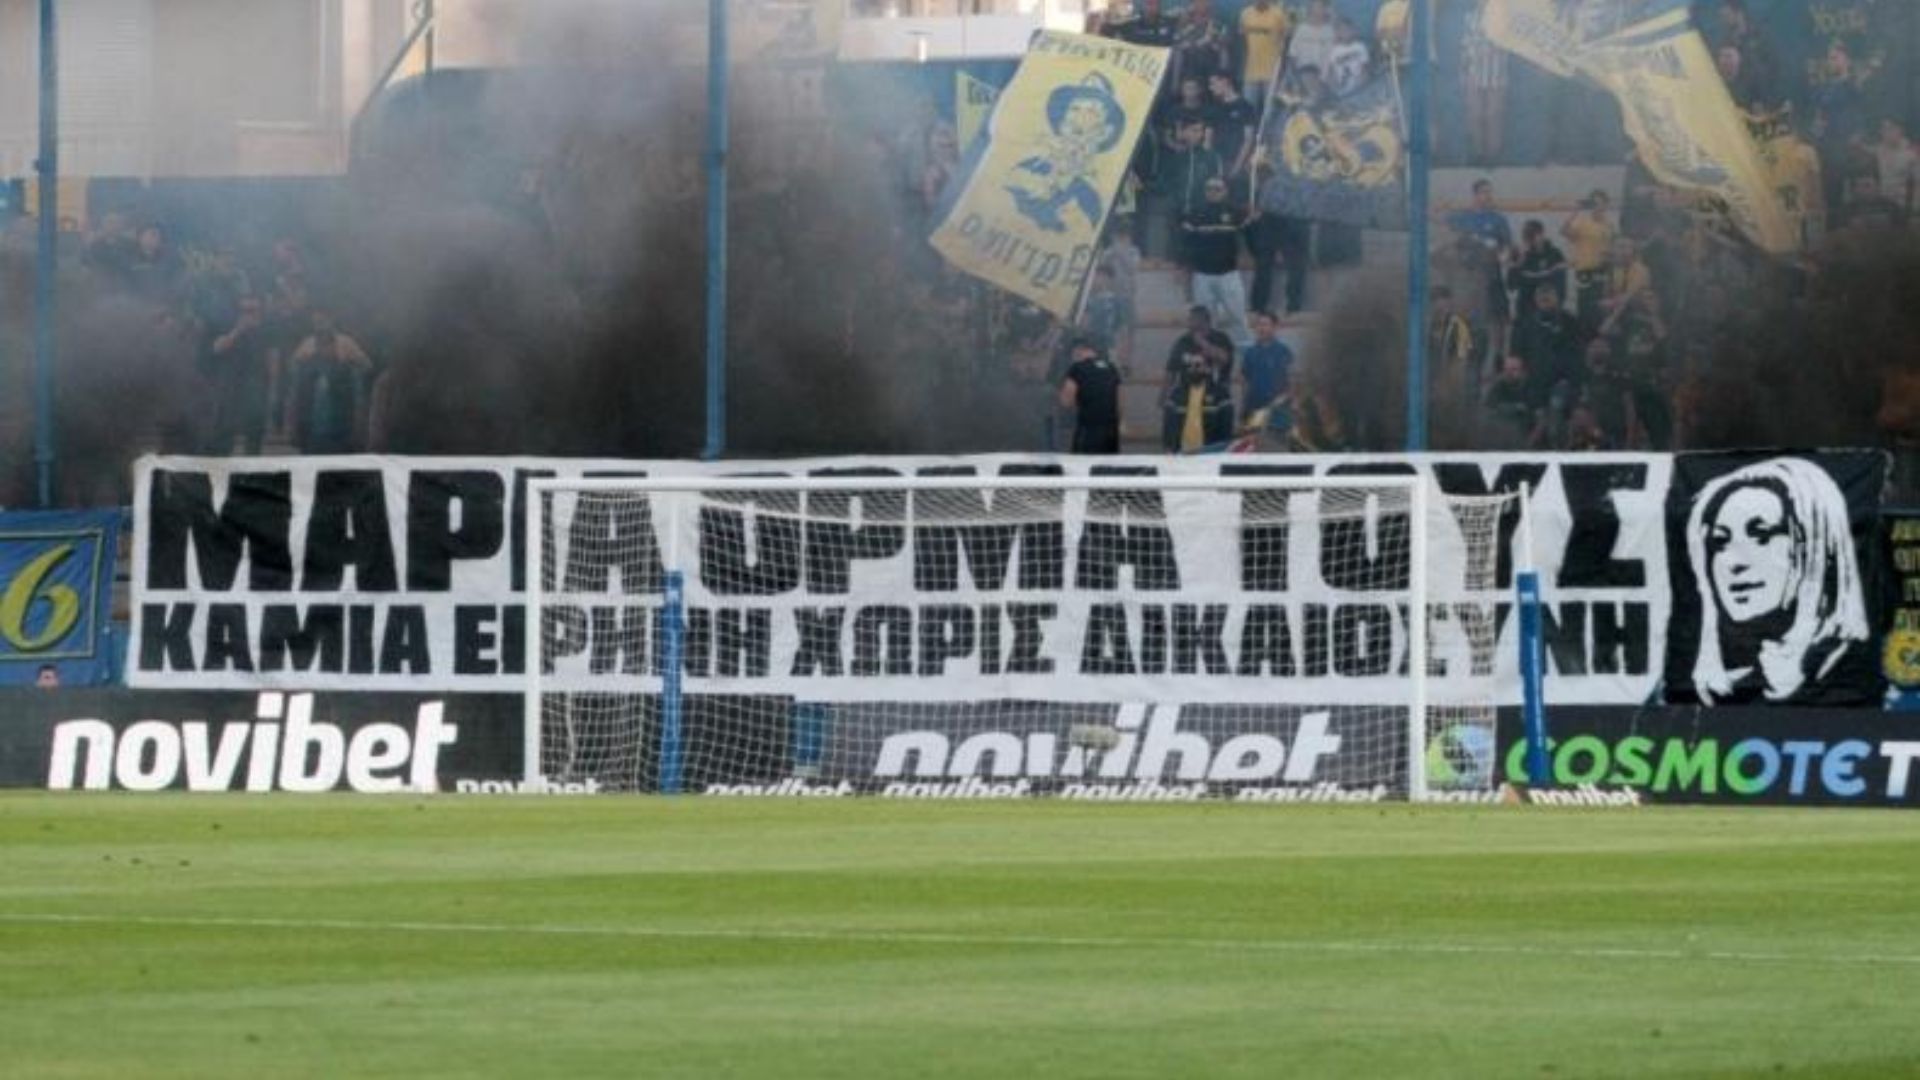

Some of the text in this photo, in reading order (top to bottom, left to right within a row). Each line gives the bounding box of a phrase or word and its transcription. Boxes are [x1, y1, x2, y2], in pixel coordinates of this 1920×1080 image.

[146, 462, 1649, 597] ΜΑΡΙΑ ΟΡΜΑ ΤΟΥΣ
[138, 603, 432, 674] ΚΑΜΙΑ
[790, 602, 1058, 678] ΧΩΡΙΣ
[48, 692, 458, 792] novibet
[455, 775, 601, 794] novbet
